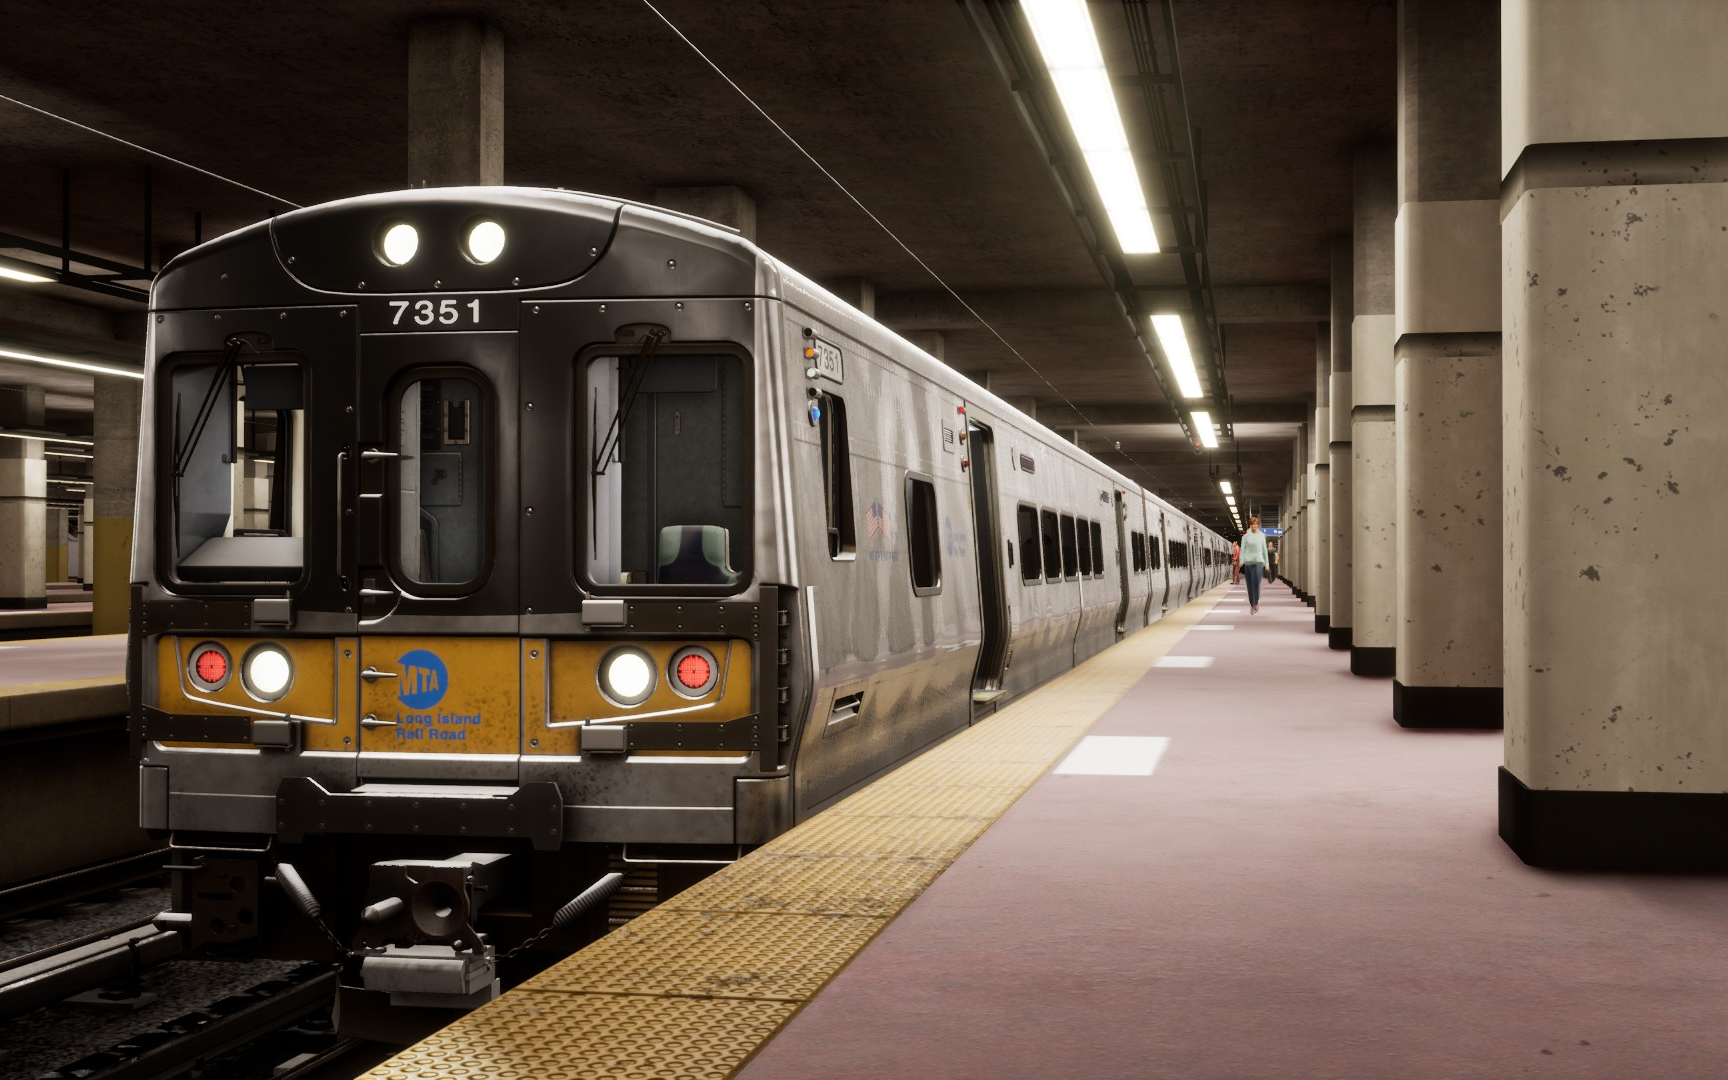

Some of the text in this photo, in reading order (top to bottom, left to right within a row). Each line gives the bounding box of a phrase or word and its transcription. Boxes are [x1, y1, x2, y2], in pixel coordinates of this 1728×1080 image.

[388, 298, 480, 325] 7351
[817, 344, 840, 374] 7351
[397, 663, 439, 696] MTA
[396, 712, 482, 728] Long Island
[396, 727, 467, 740] Rail Road
